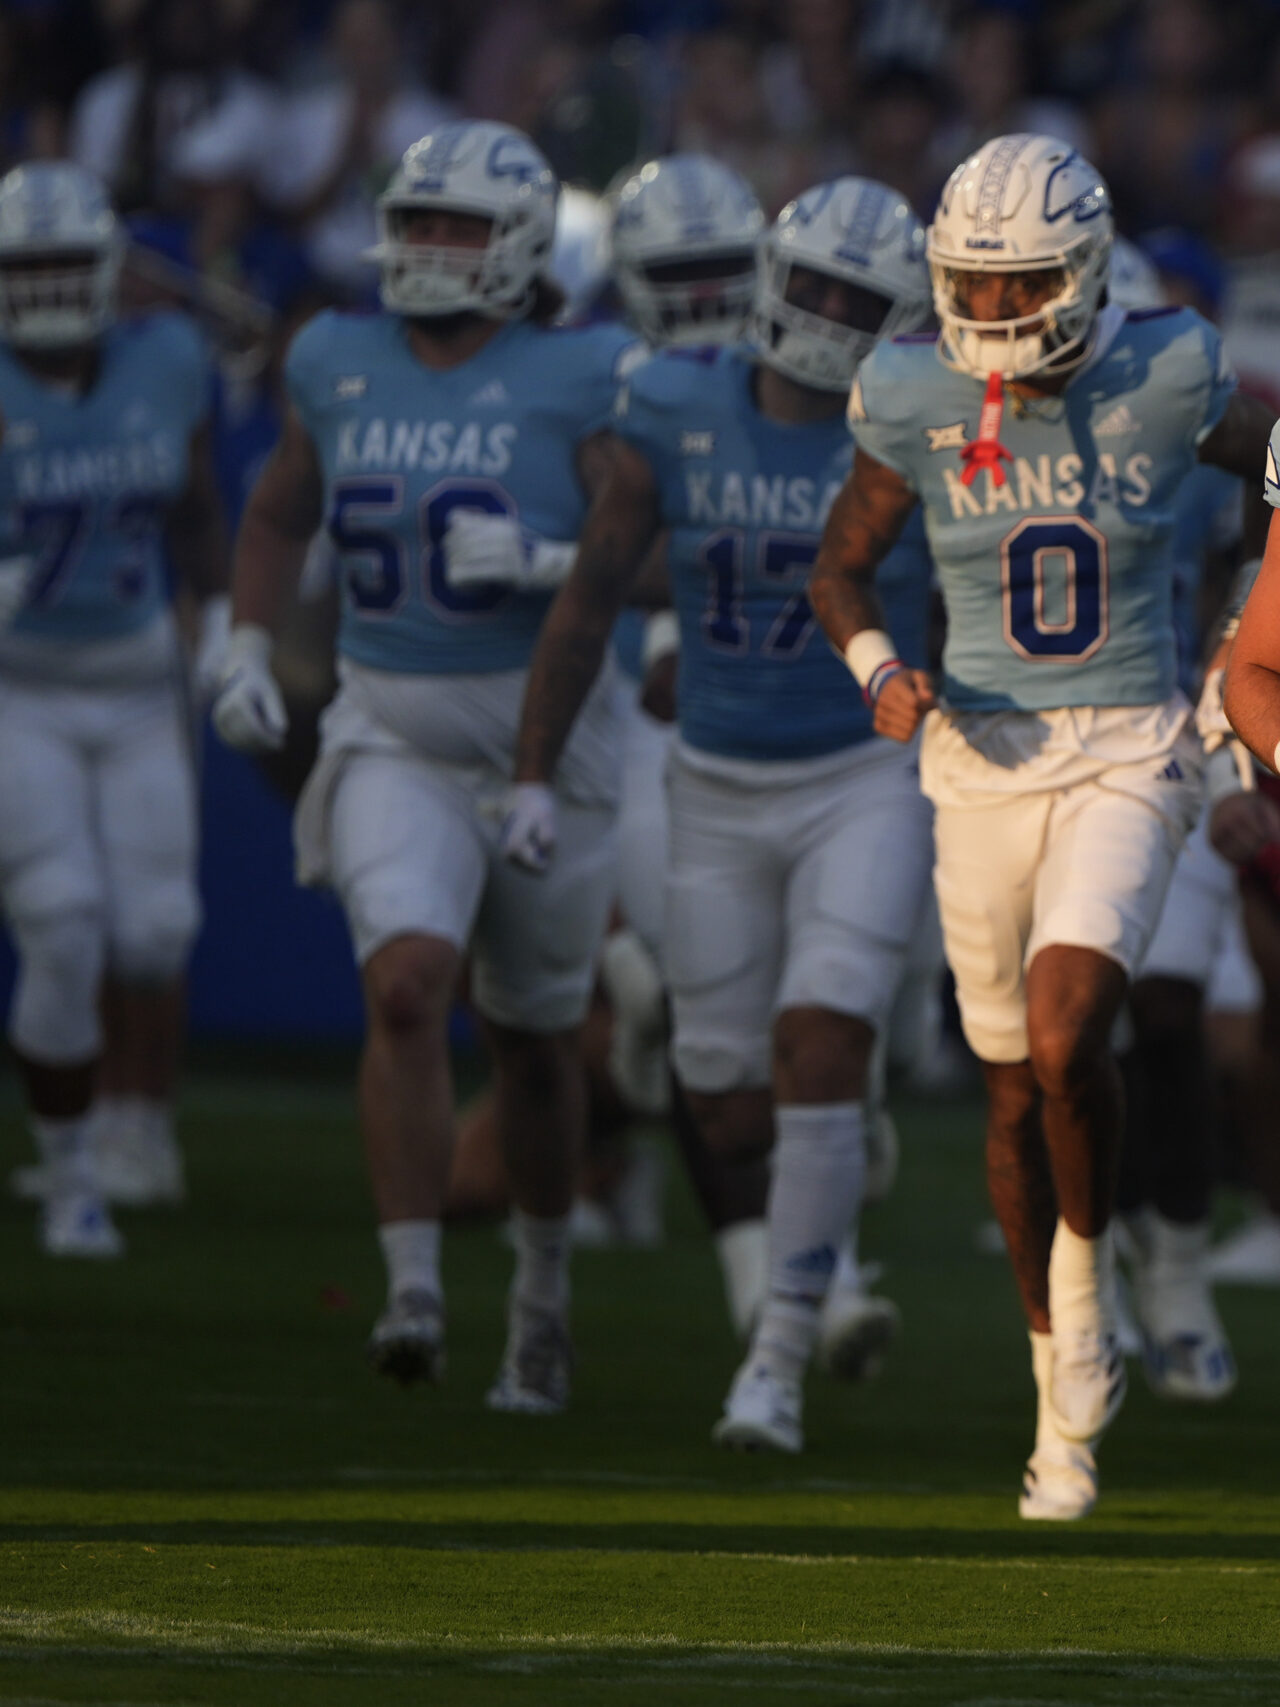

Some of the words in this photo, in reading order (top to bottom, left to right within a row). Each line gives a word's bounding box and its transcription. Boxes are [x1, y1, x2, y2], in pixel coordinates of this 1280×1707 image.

[335, 417, 518, 475] KANSAS
[941, 451, 1154, 519] KANSAS
[697, 524, 824, 662] 17
[999, 514, 1111, 664] 0
